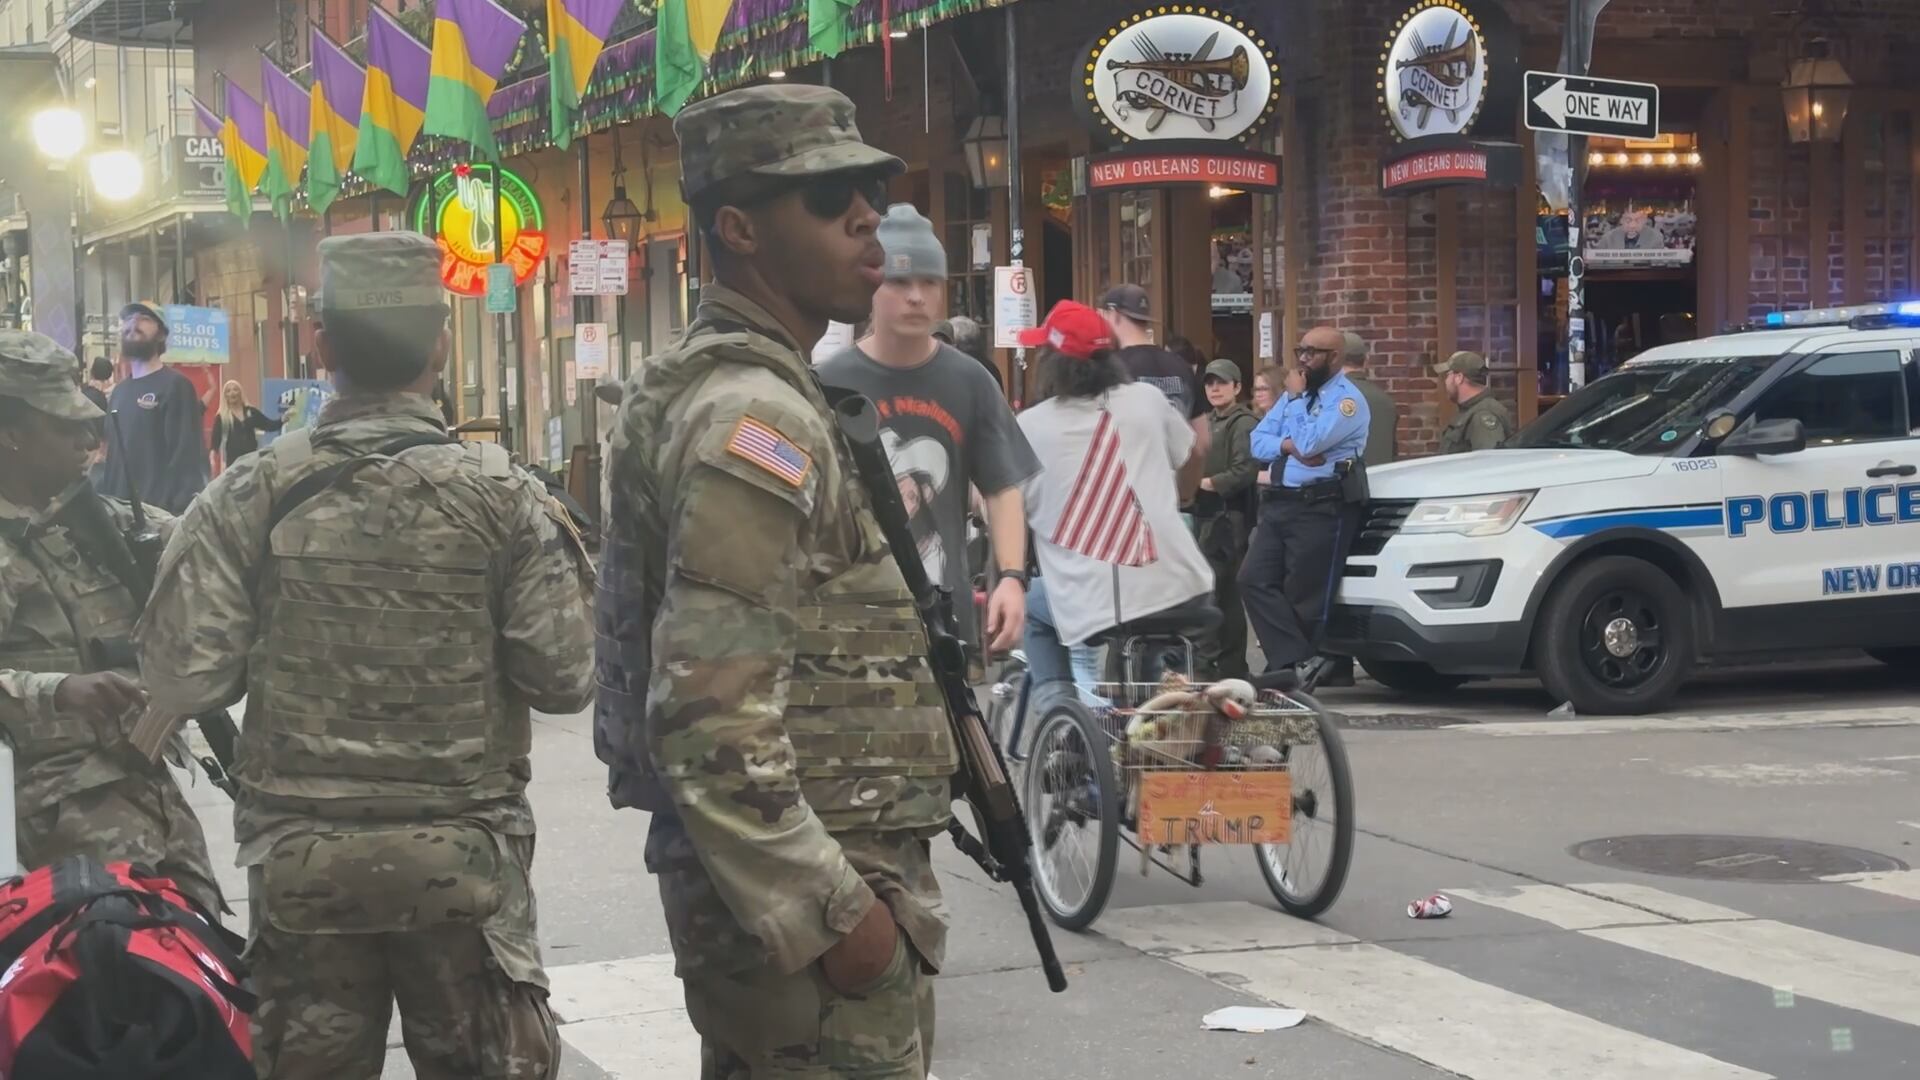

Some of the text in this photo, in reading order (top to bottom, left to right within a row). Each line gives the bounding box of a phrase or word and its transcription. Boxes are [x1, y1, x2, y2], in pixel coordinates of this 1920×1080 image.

[1135, 71, 1220, 117] CORNET
[1410, 67, 1459, 108] CORNET
[1566, 94, 1643, 121] ONE WAY
[1093, 158, 1267, 181] NEW ORLEANS CUISINE
[1390, 162, 1409, 183] NEW
[1412, 153, 1451, 176] ORLEANS
[355, 289, 403, 306] LEWIS
[172, 334, 220, 350] SHOTS
[1672, 459, 1718, 472] 16029
[1725, 482, 1920, 538] POLICE
[1822, 564, 1881, 596] NEW
[1160, 815, 1266, 845] TRUMP
